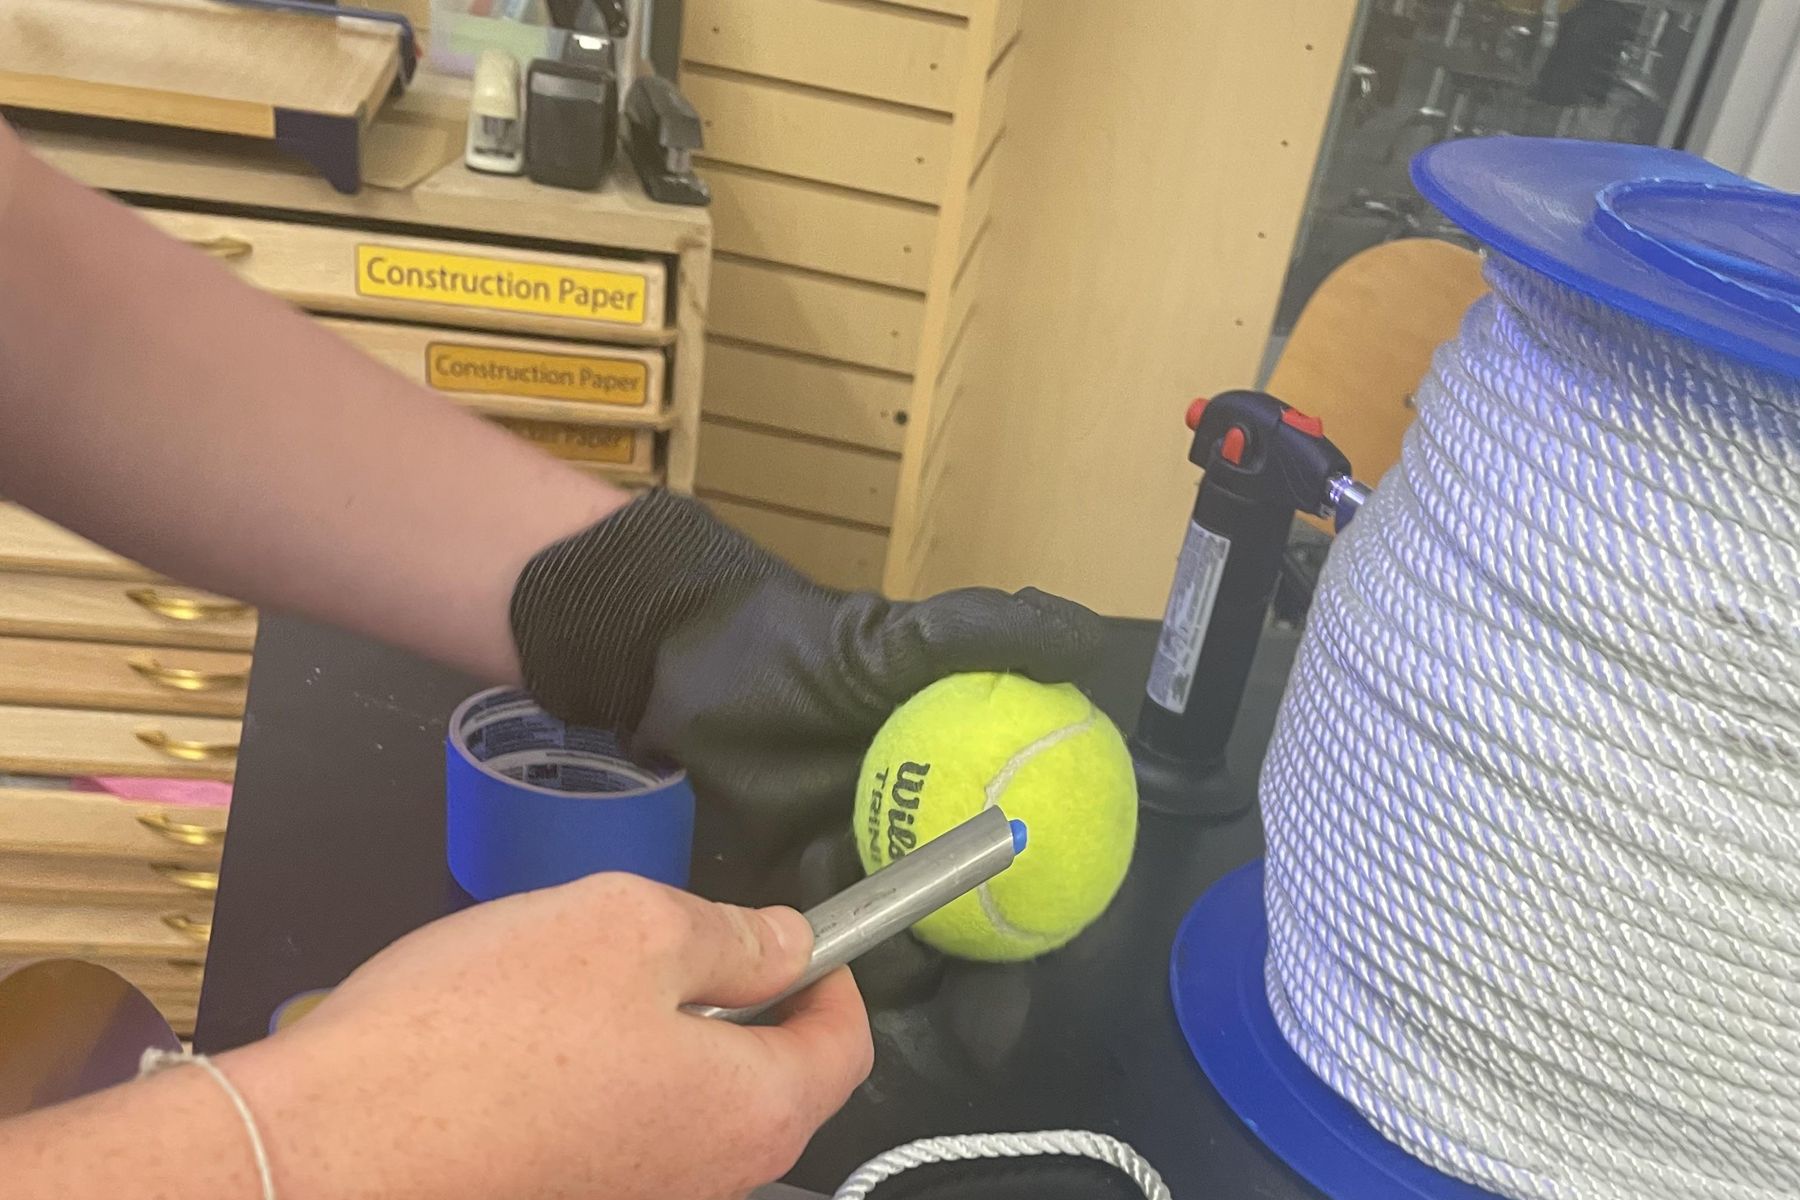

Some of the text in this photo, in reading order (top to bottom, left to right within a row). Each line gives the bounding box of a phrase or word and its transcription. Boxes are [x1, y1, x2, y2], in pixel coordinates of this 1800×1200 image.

[367, 256, 637, 313] Construction Paper
[435, 355, 639, 393] Construction Paper
[868, 767, 889, 863] TRINI
[888, 761, 930, 860] Wils
